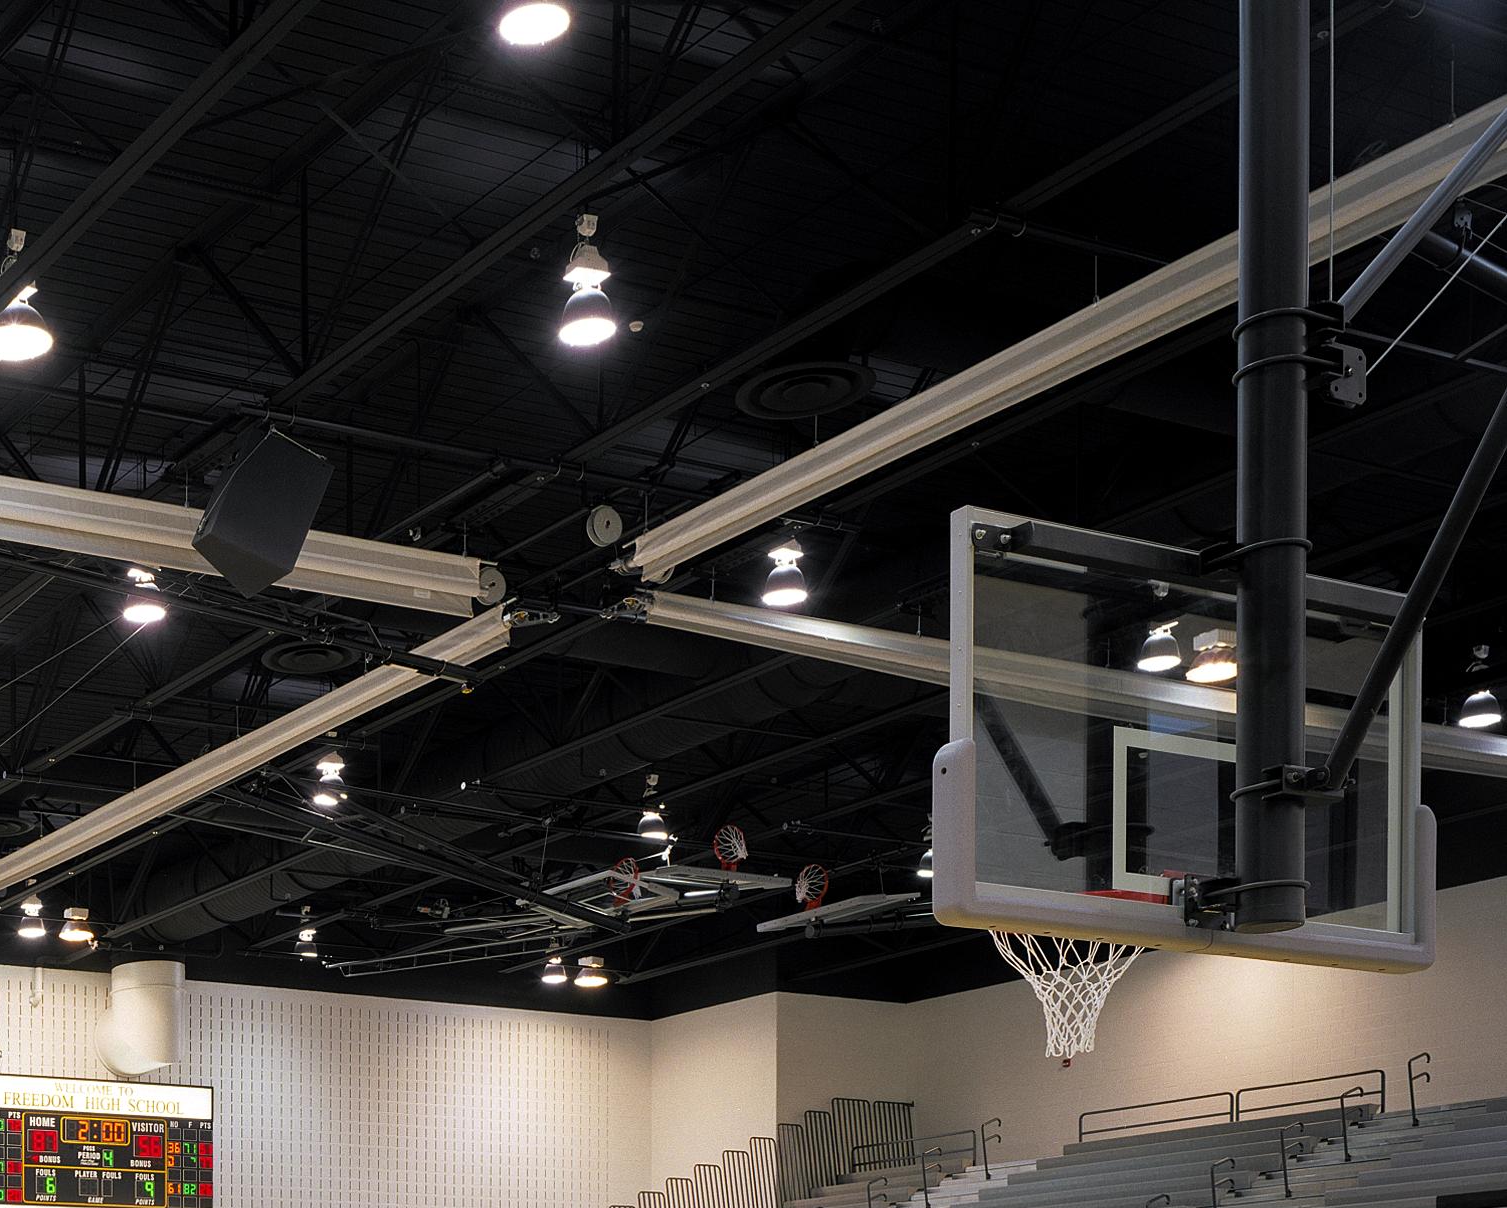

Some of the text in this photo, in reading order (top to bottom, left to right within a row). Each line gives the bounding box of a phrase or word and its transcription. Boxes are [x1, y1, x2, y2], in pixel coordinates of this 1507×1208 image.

[54, 1082, 134, 1097] WELCOME TO
[3, 1091, 184, 1115] FREEDOM HIGH SCHOOL
[8, 1111, 21, 1119] PTS
[29, 1116, 56, 1127] HOME
[170, 1120, 179, 1128] NO
[199, 1122, 212, 1130] PTS
[78, 1120, 125, 1142] 2:00
[132, 1122, 164, 1133] VISITOR
[32, 1130, 58, 1153] 87
[139, 1136, 162, 1158] 56
[39, 1155, 61, 1164] BONUS
[77, 1151, 101, 1160] PERIOD
[103, 1151, 113, 1166] 4
[130, 1159, 152, 1168] BONUS
[35, 1168, 56, 1176] FOULS
[74, 1170, 122, 1179] PLAYER FOULS
[135, 1173, 155, 1181] FOULS
[46, 1176, 56, 1194] 6
[144, 1181, 154, 1198] 9
[135, 1198, 155, 1206] POINTS
